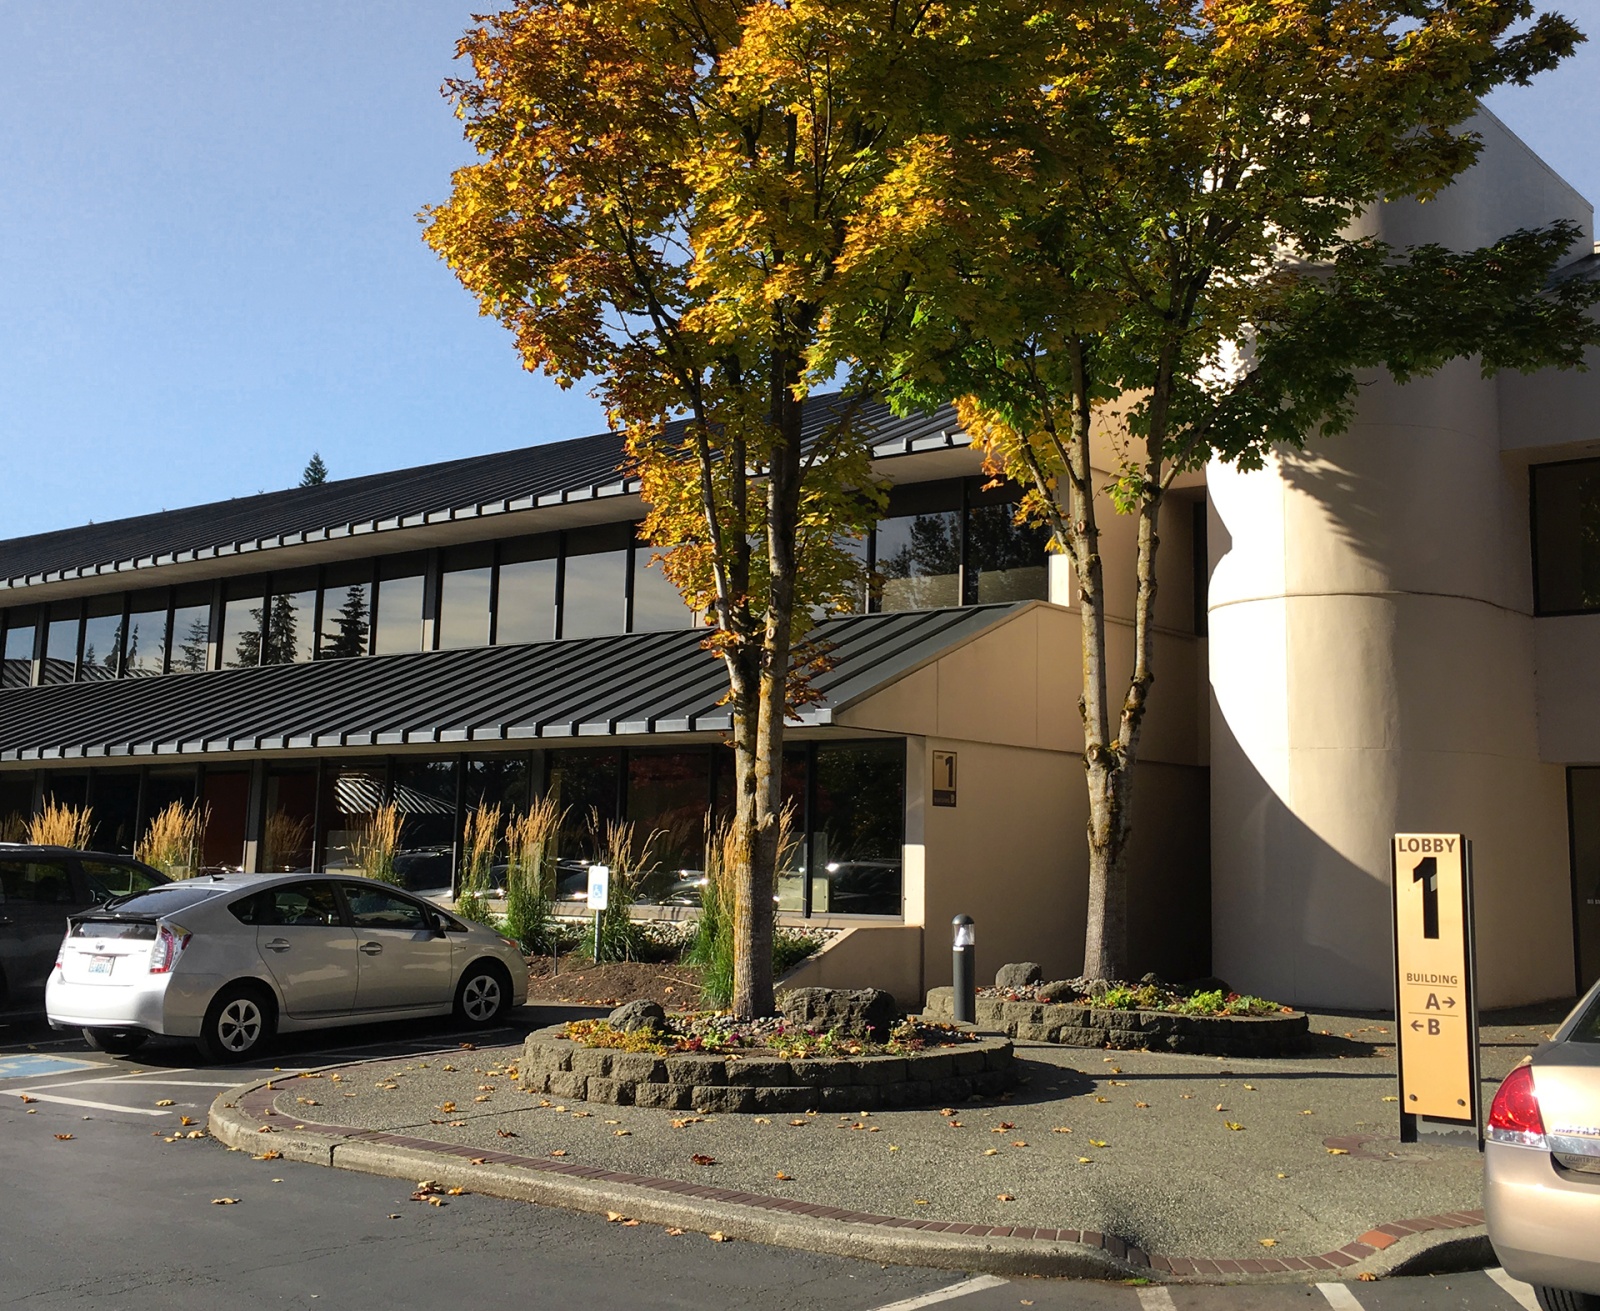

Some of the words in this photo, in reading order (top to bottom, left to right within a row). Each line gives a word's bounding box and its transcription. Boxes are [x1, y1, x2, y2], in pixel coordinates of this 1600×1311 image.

[945, 756, 953, 787] 1
[1398, 838, 1456, 853] LOBBY
[1412, 856, 1440, 939] 1
[1406, 972, 1458, 985] BUILDING
[1425, 992, 1441, 1010] A
[1428, 1018, 1441, 1036] B
